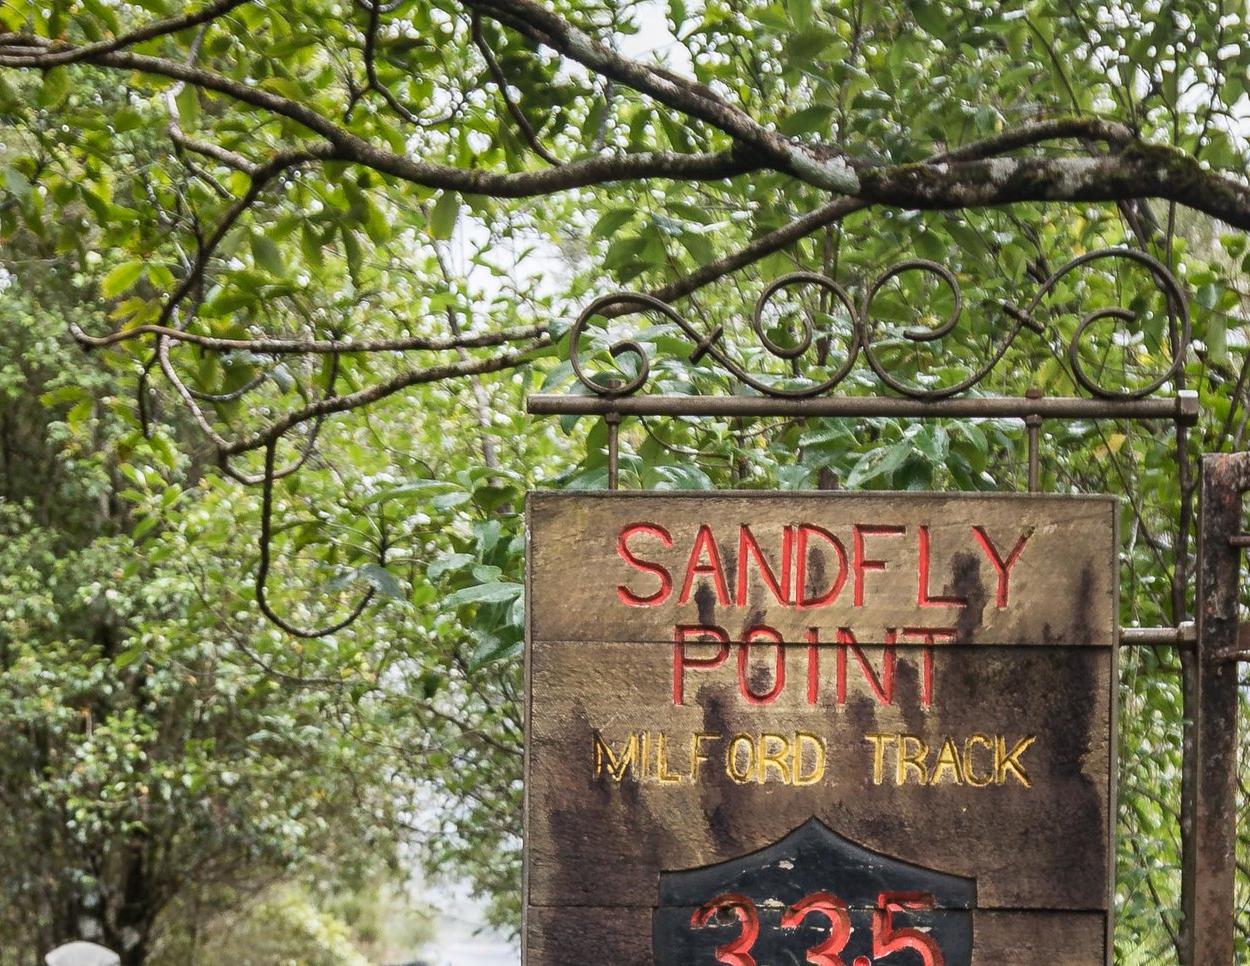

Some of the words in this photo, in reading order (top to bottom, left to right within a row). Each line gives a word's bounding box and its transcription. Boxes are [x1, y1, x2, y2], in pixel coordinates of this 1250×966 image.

[616, 521, 1037, 609] SANDFLY
[671, 624, 957, 706] POINT
[592, 730, 828, 785] MILFORD
[865, 731, 1037, 788] TRACK
